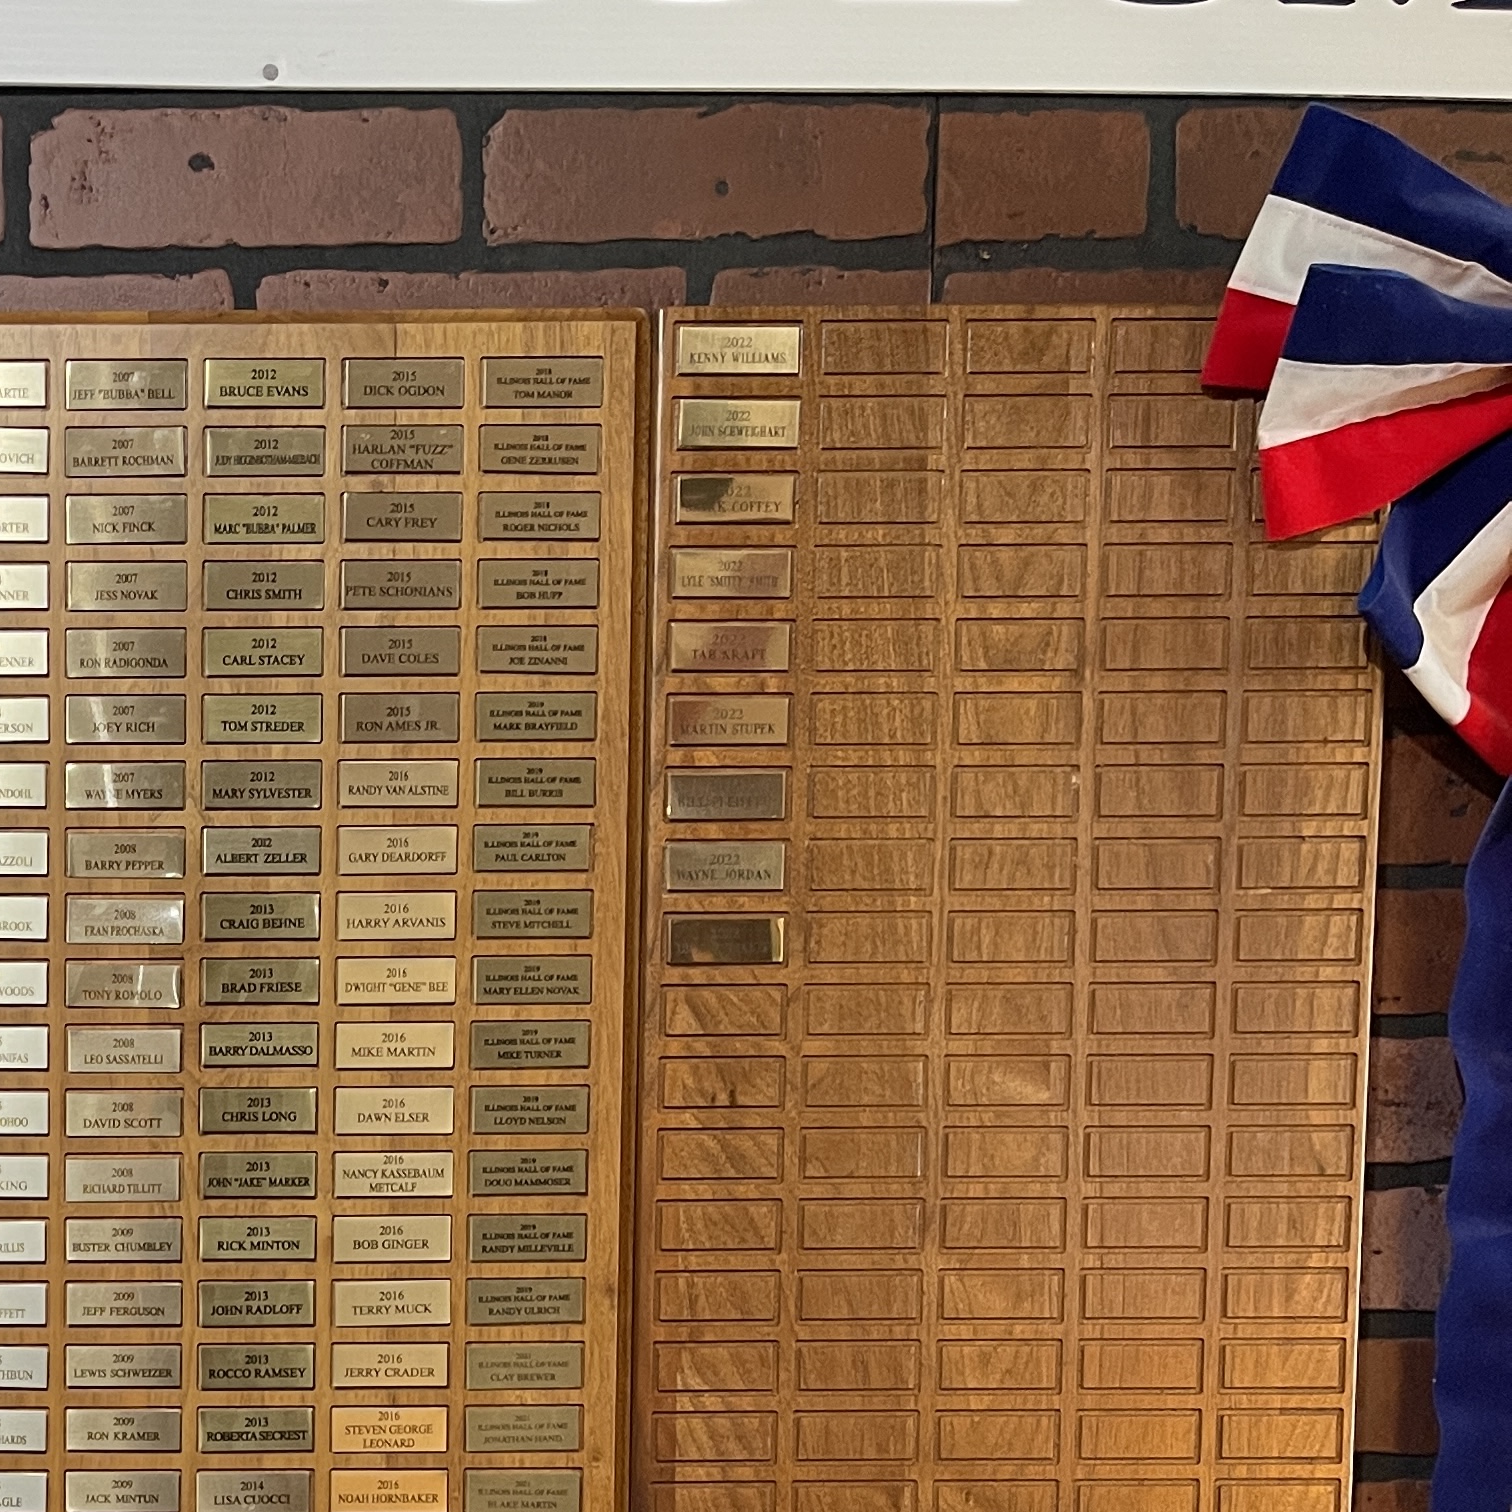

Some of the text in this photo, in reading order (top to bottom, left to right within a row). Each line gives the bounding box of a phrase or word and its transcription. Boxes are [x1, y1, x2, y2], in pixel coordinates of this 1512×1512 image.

[724, 336, 753, 348] 2022
[690, 352, 787, 364] KENNY WILLIAMS
[251, 369, 276, 380] 2012
[392, 371, 416, 382] 2015
[220, 386, 308, 397] BRUCE EVANS
[363, 385, 445, 396] DICK OGDON
[112, 506, 134, 516] 2007
[389, 503, 415, 513] 2015
[92, 522, 156, 533] NICK FINCK
[367, 517, 437, 528] CARY FREY
[251, 705, 276, 715] 2012
[221, 721, 305, 732] TOM STREDER
[114, 844, 136, 854] 2008
[85, 860, 164, 870] BARRY PEPPER
[250, 904, 274, 914] 2013
[220, 918, 305, 929] CRAIG BEHNE
[382, 1033, 406, 1043] 2016
[351, 1047, 436, 1057] MIKE MARTIN
[247, 1227, 270, 1237] 2013
[217, 1241, 300, 1251] RICK MINTON
[377, 1354, 402, 1364] 2016
[344, 1368, 435, 1377] JERRY CRADER
[113, 1417, 134, 1426] 2009
[87, 1432, 160, 1441] RON KRAMER
